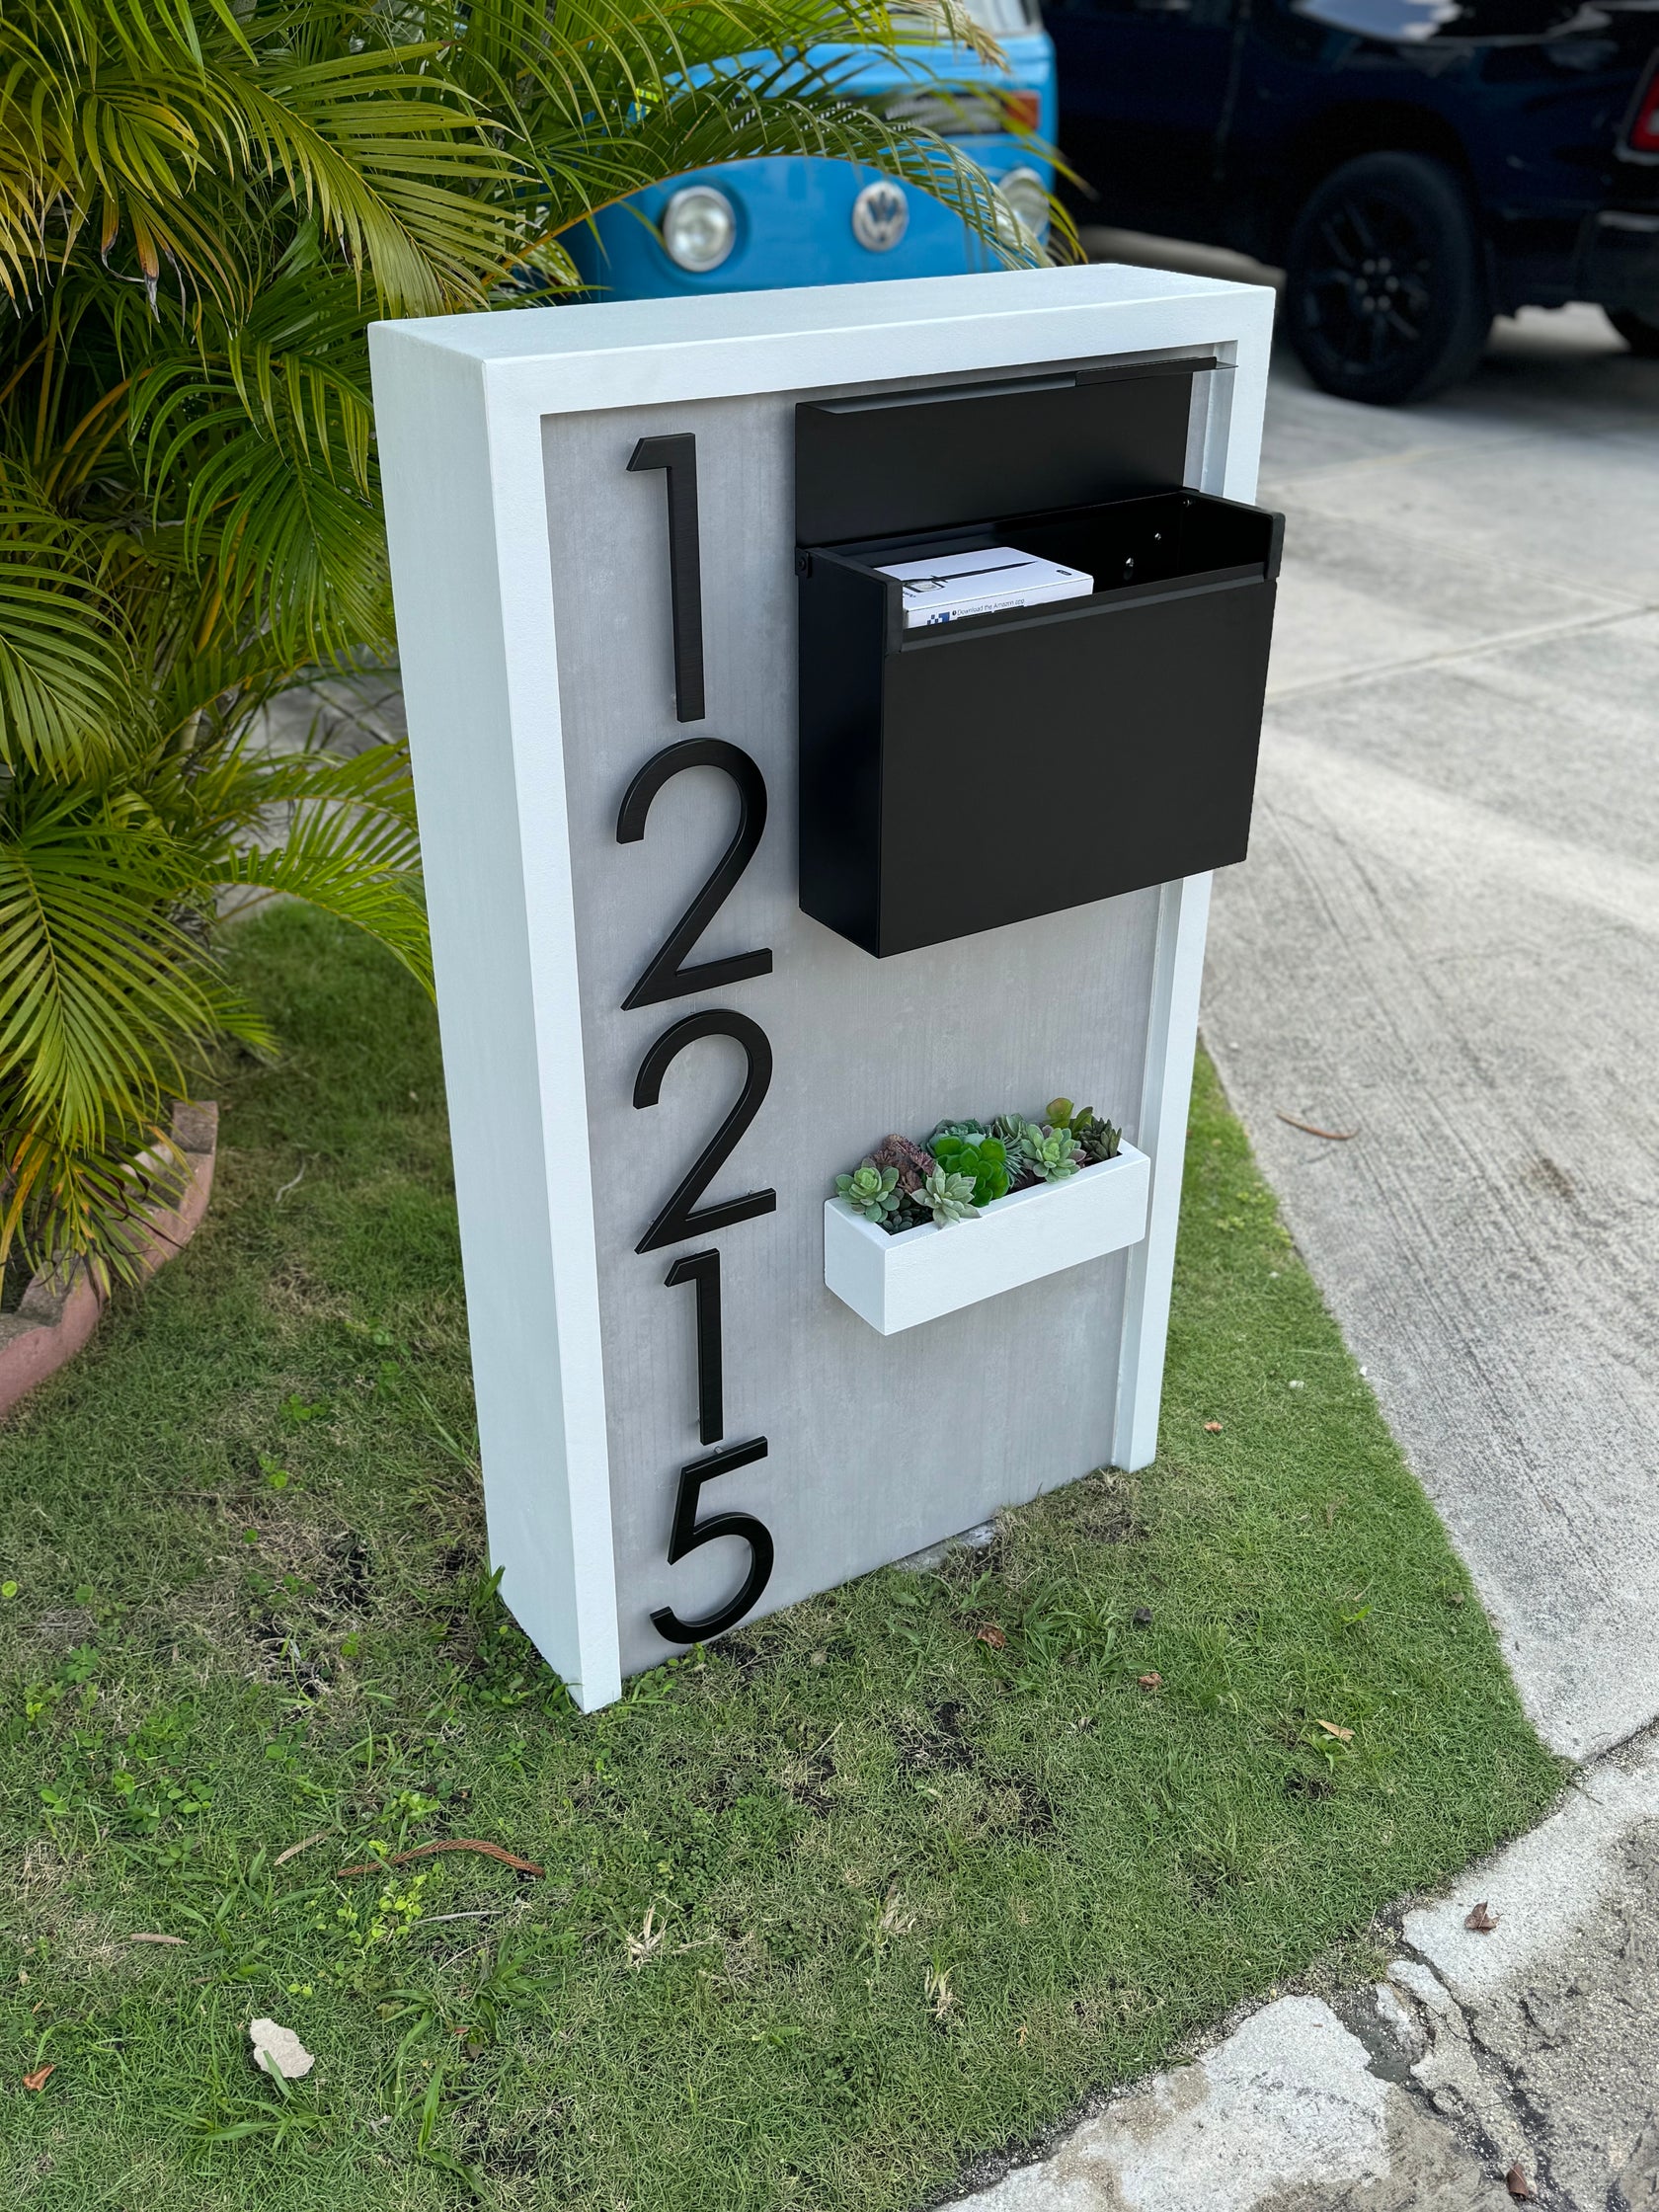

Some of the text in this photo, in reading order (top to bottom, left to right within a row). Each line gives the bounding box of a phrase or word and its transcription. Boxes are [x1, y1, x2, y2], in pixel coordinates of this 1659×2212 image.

[957, 605, 984, 616] Download
[993, 599, 1014, 609] Amazon
[616, 433, 776, 1645] 12215
